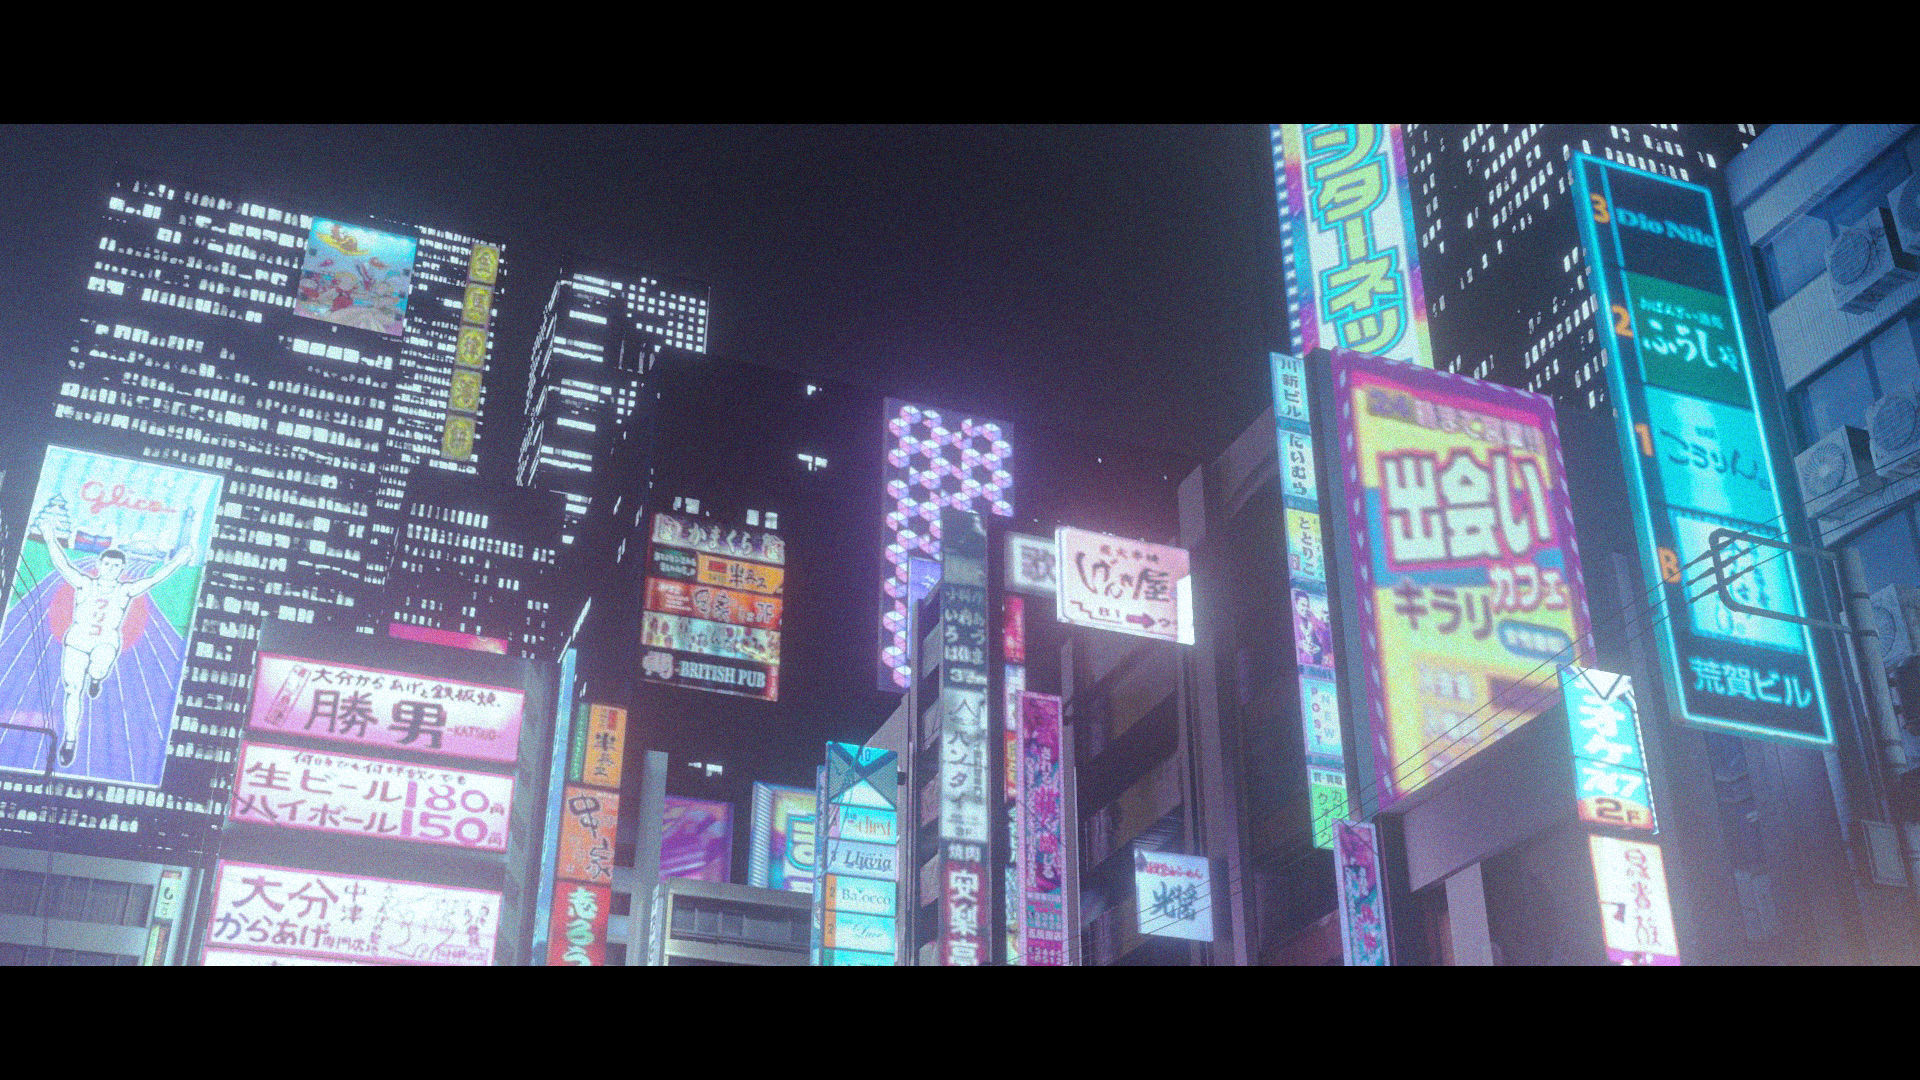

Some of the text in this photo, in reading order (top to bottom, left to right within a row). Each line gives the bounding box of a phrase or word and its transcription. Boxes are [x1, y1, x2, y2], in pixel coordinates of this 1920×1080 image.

[1590, 193, 1610, 223] 3
[1611, 305, 1634, 338] 2
[1634, 423, 1653, 456] 1
[81, 480, 176, 514] Glico
[1384, 454, 1553, 561] 出会い
[1658, 547, 1681, 583] B
[1491, 565, 1571, 612] カフェ
[1394, 581, 1492, 641] キラリ
[679, 660, 737, 686] BRITISH
[737, 667, 767, 689] PUB
[1690, 655, 1812, 708] 荒賀ビル
[246, 761, 402, 804] 生ビール
[240, 793, 399, 835] ハイボール
[1595, 797, 1640, 825] 2F
[232, 875, 339, 919] 大分
